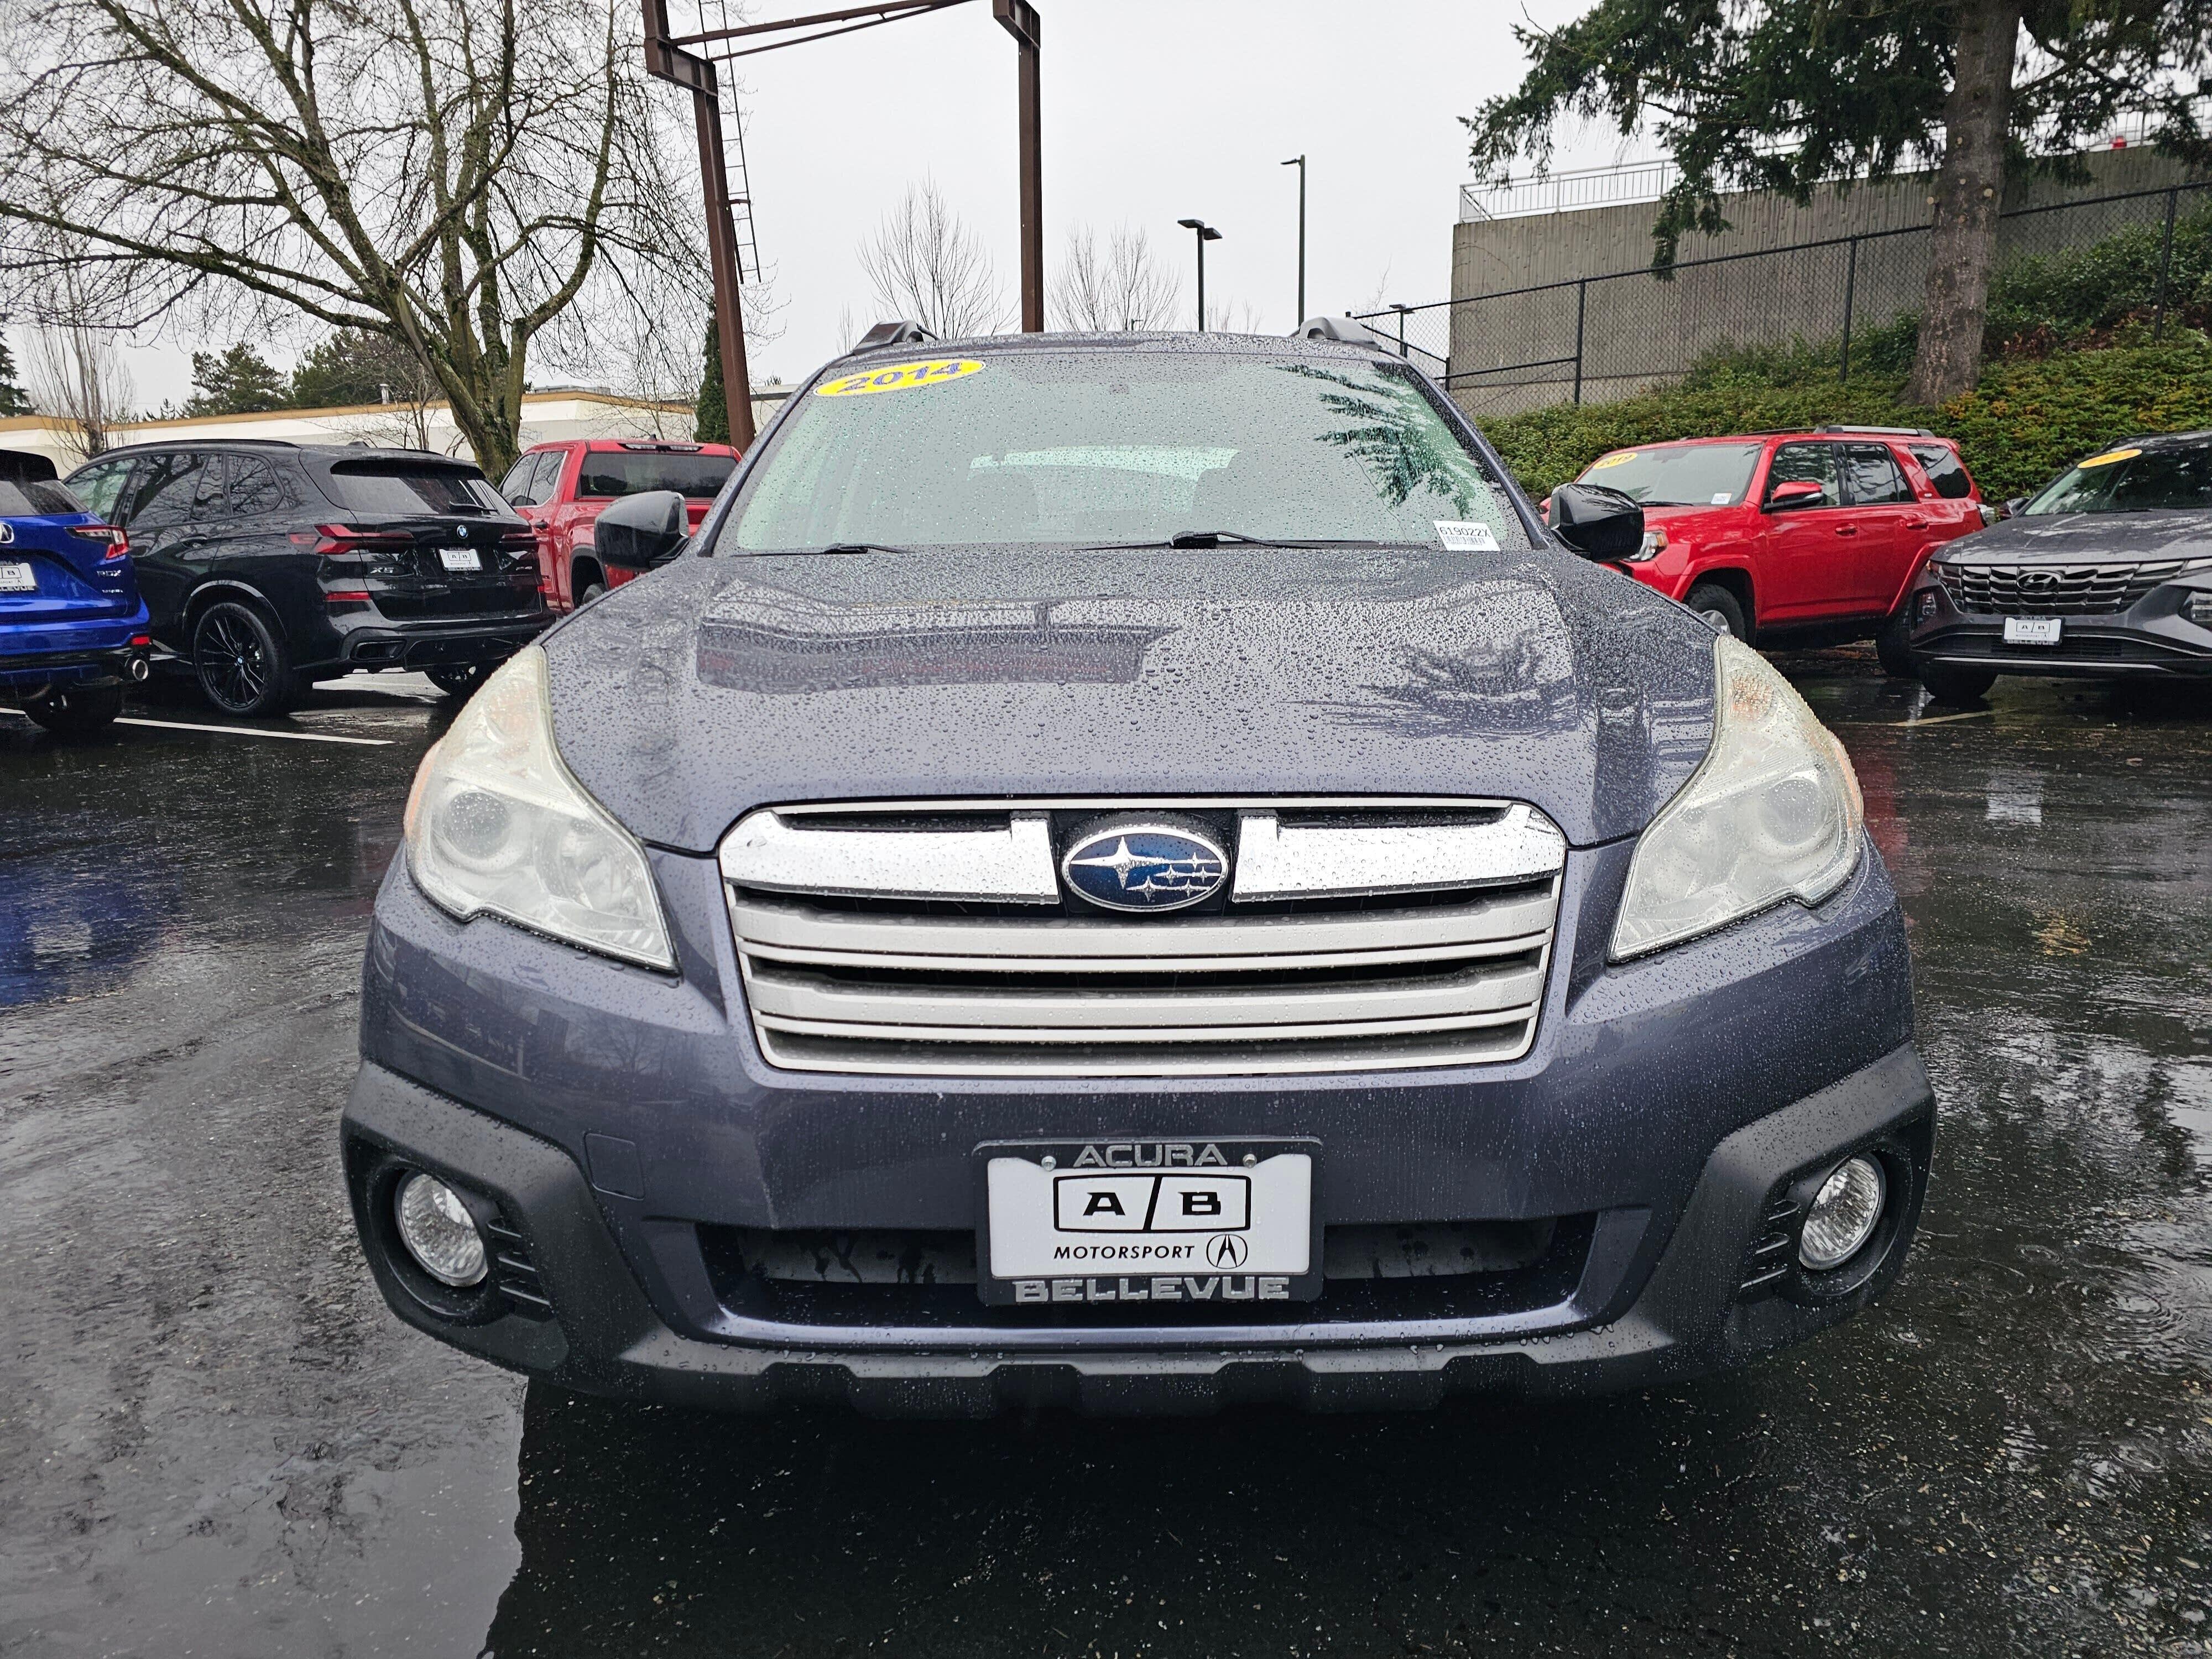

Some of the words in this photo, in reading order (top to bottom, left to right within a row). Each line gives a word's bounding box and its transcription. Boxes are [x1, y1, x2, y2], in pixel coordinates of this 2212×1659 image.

[836, 362, 961, 393] 2014
[1439, 526, 1491, 538] 619022X
[1072, 1144, 1228, 1168] ACURA
[1053, 1245, 1195, 1260] MOTORSPORT
[1012, 1275, 1290, 1303] BELLEVUE
